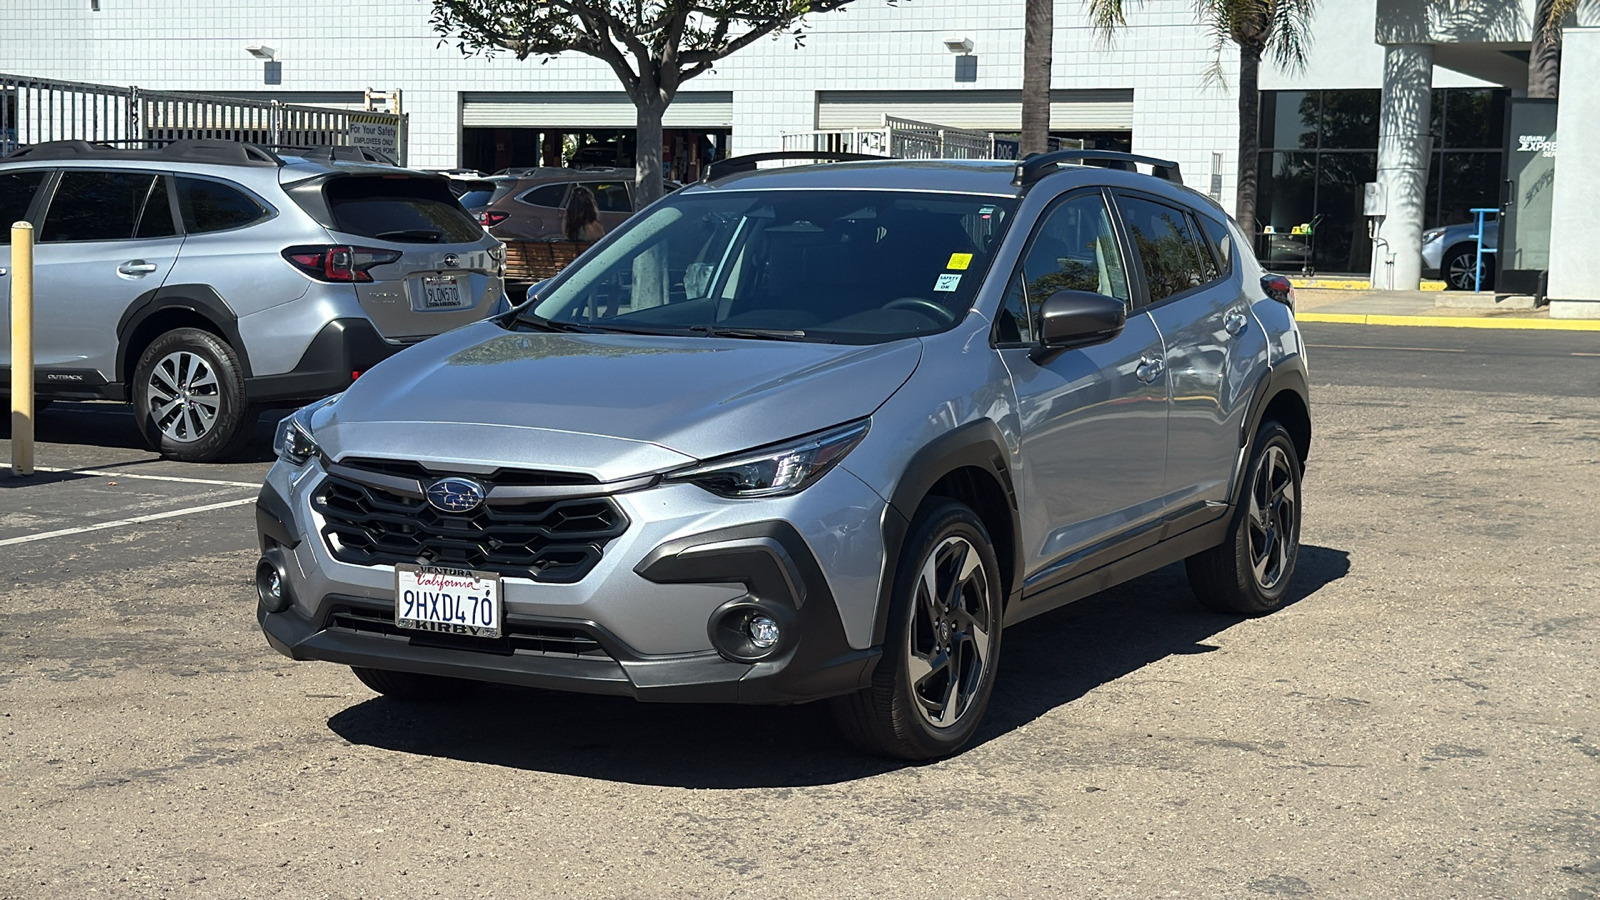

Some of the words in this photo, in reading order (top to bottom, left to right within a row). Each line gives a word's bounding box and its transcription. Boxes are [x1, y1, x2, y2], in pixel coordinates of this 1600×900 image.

[350, 124, 360, 133] For
[362, 125, 376, 135] Your
[378, 126, 396, 138] Safety
[354, 137, 381, 145] EMPLOYEES
[997, 144, 1012, 160] DOG
[421, 567, 473, 577] VENTURA
[418, 573, 480, 591] California
[404, 590, 493, 626] 9HXD470
[415, 620, 481, 636] KIRBY
